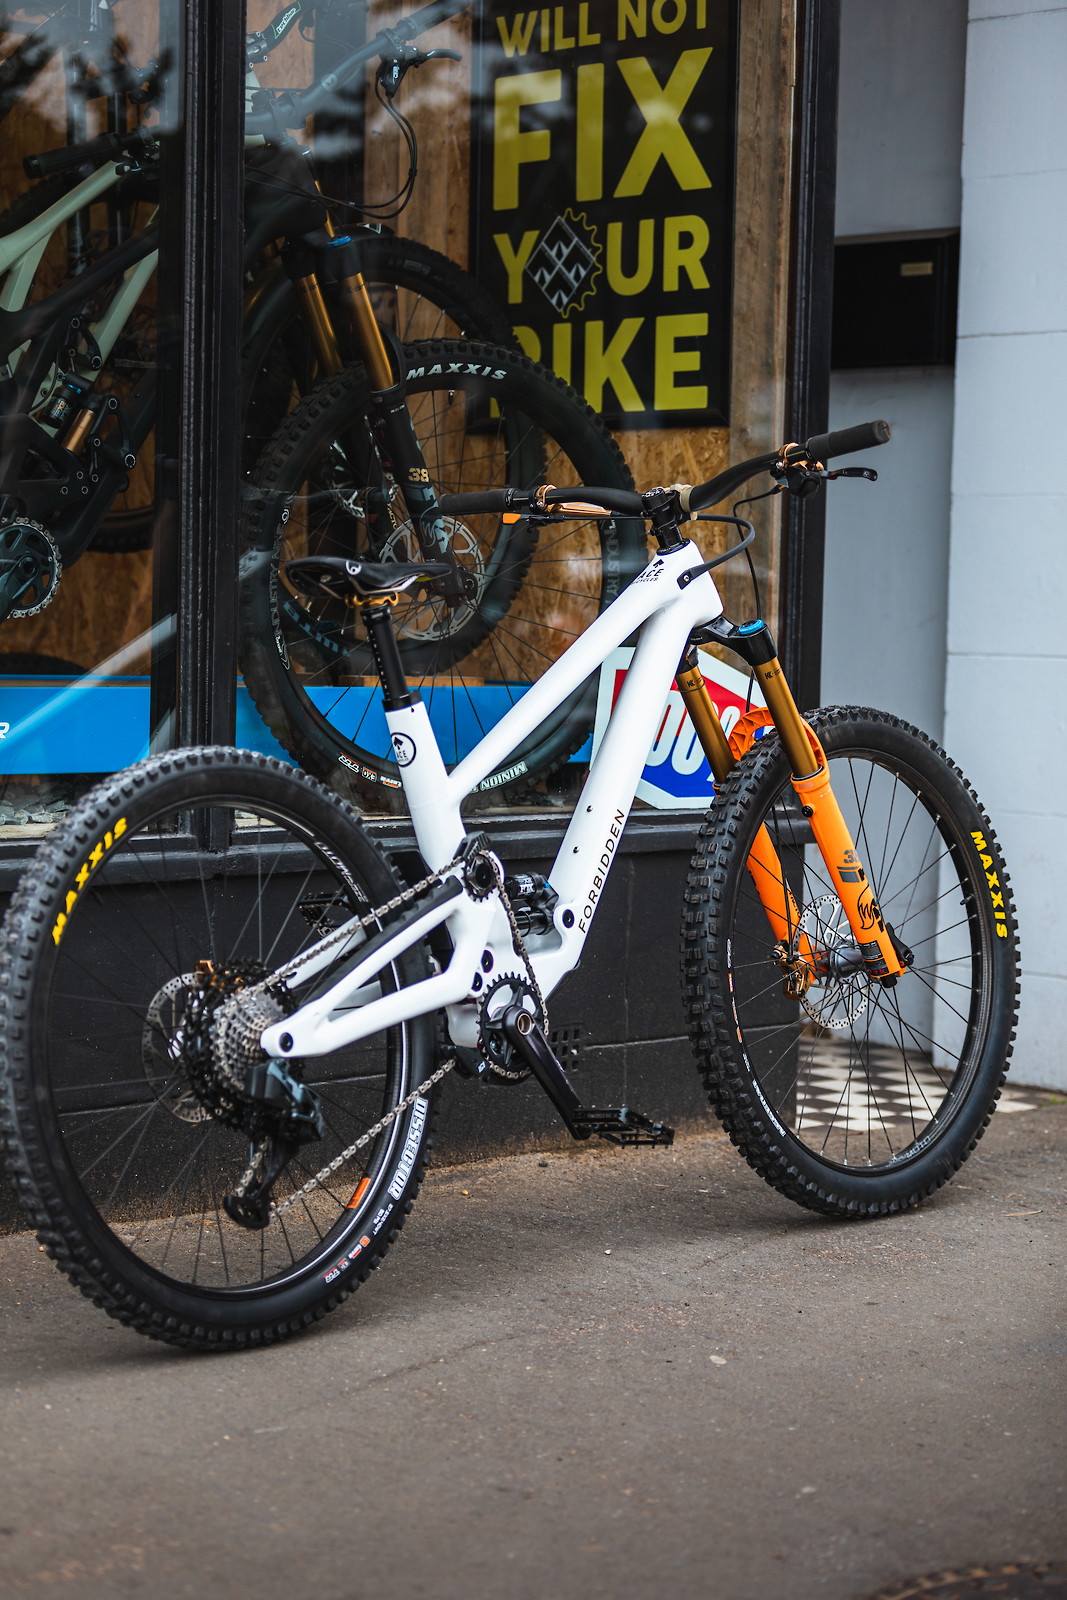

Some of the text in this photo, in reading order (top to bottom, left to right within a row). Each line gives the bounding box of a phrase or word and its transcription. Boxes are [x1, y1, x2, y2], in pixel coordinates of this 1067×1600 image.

[496, 2, 601, 58] WILL
[493, 47, 713, 211] FIX
[406, 362, 508, 381] MAXXIS
[408, 467, 430, 483] 38
[480, 761, 529, 791] MINION
[52, 816, 128, 946] MAXXIS
[578, 808, 626, 934] FORBIDDEN
[969, 830, 1009, 939] MAXXIS
[388, 1097, 429, 1201] DISSECTOR
